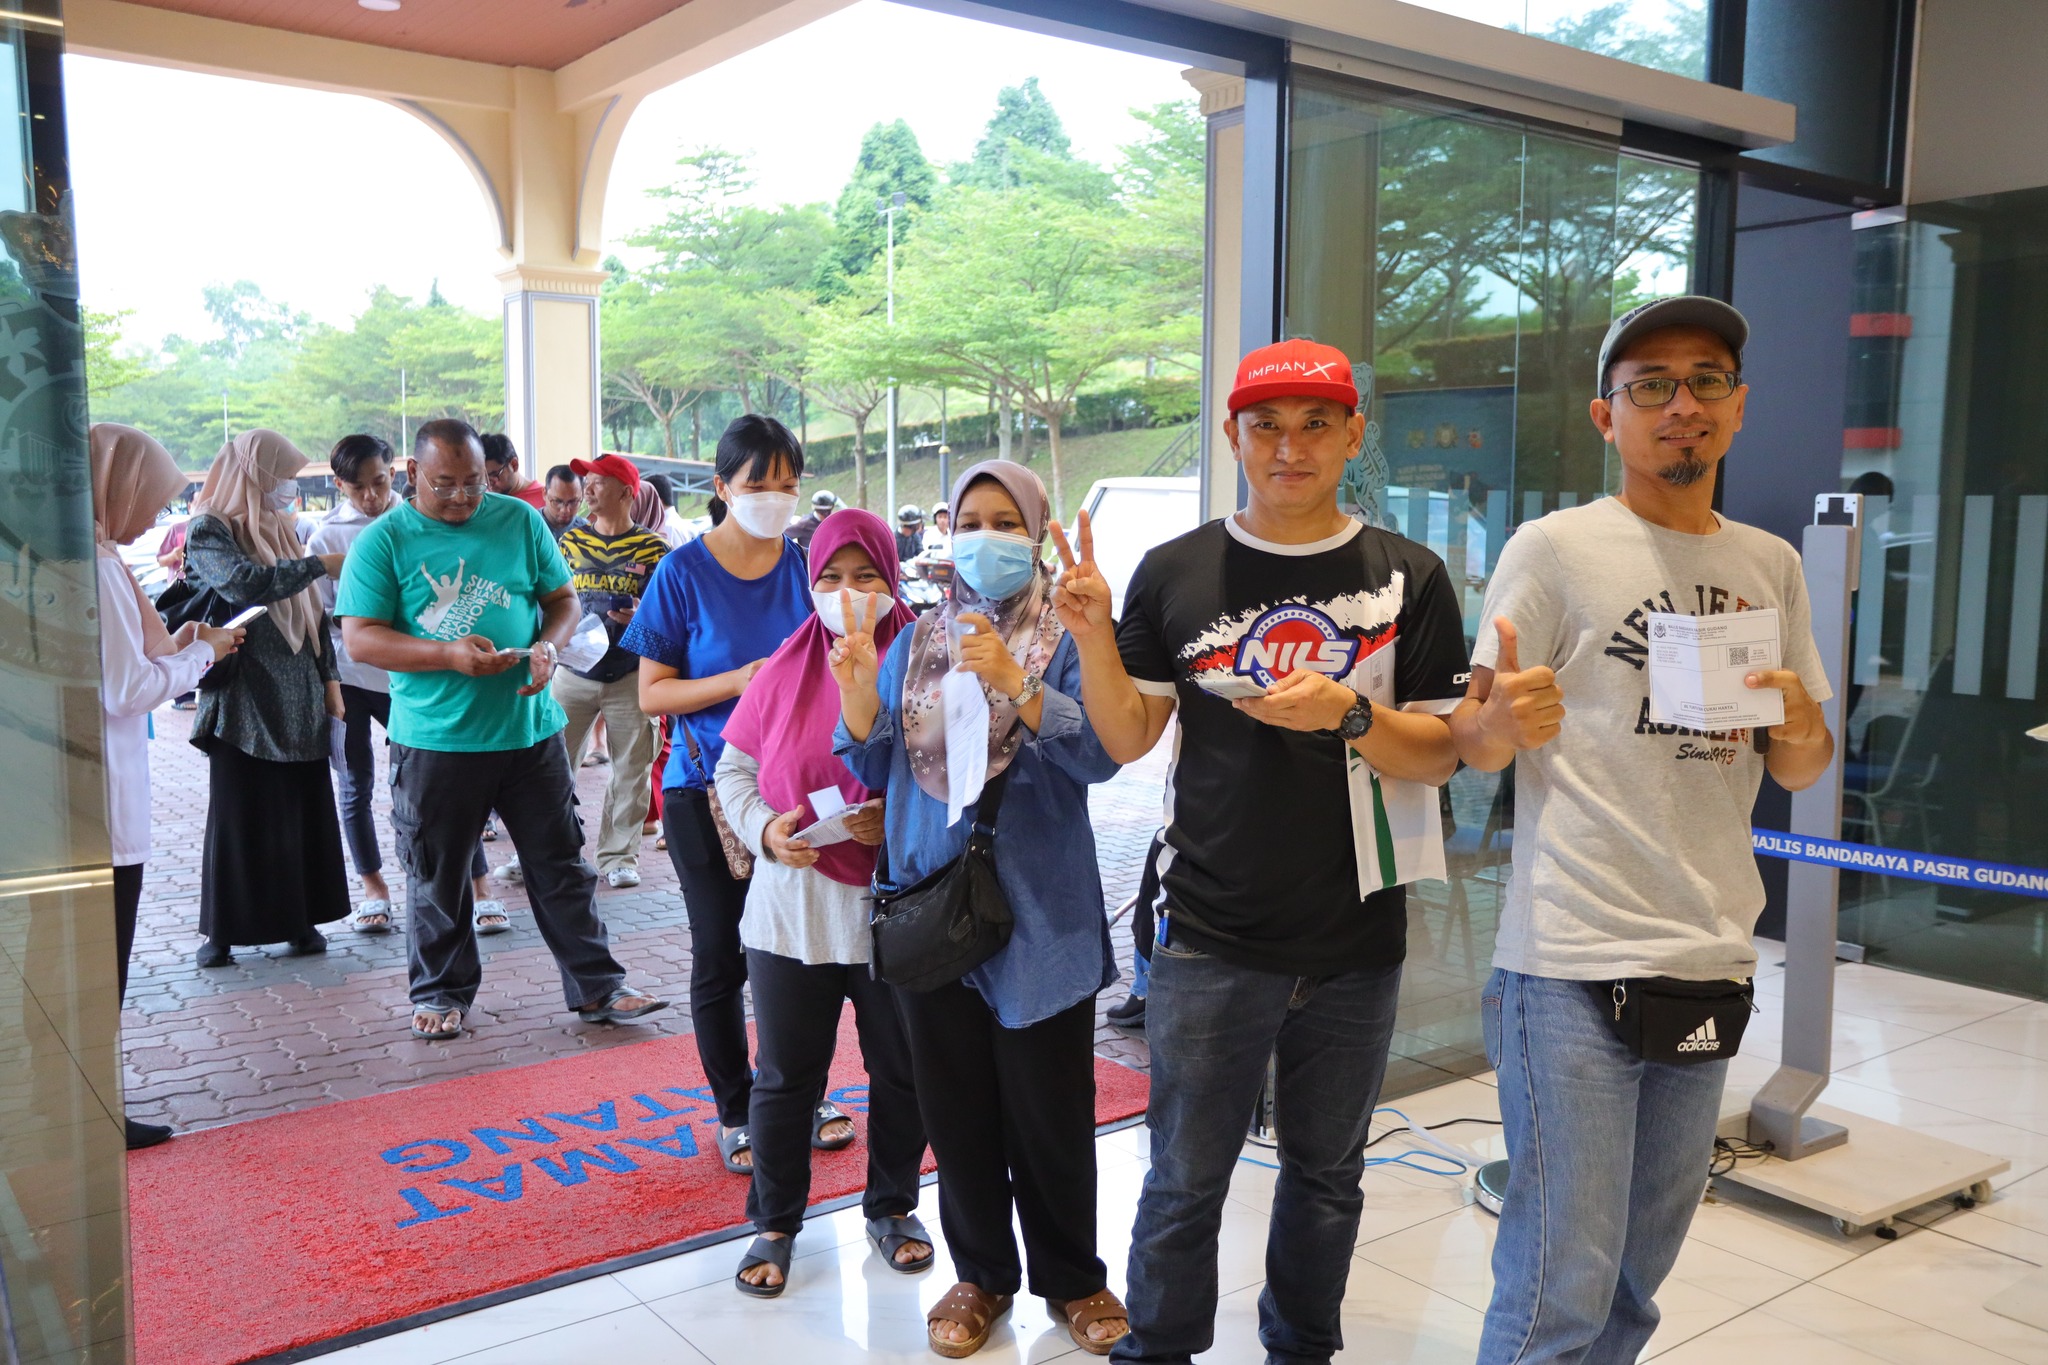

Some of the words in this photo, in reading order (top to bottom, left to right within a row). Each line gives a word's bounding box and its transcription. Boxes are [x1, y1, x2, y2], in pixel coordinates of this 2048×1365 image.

[470, 575, 511, 602] SUKAN
[435, 593, 469, 639] LEMBAGA
[443, 594, 477, 641] PELABUHAN
[452, 597, 488, 640] JOHOR
[1239, 639, 1353, 673] NILS
[1752, 834, 1802, 855] MAJLIS
[1805, 843, 1909, 872] BANDARAYA
[1913, 859, 1970, 881] PASIR
[1974, 868, 2048, 891] GUDAN
[1677, 1038, 1721, 1052] adidas
[380, 1069, 758, 1173] ATANG
